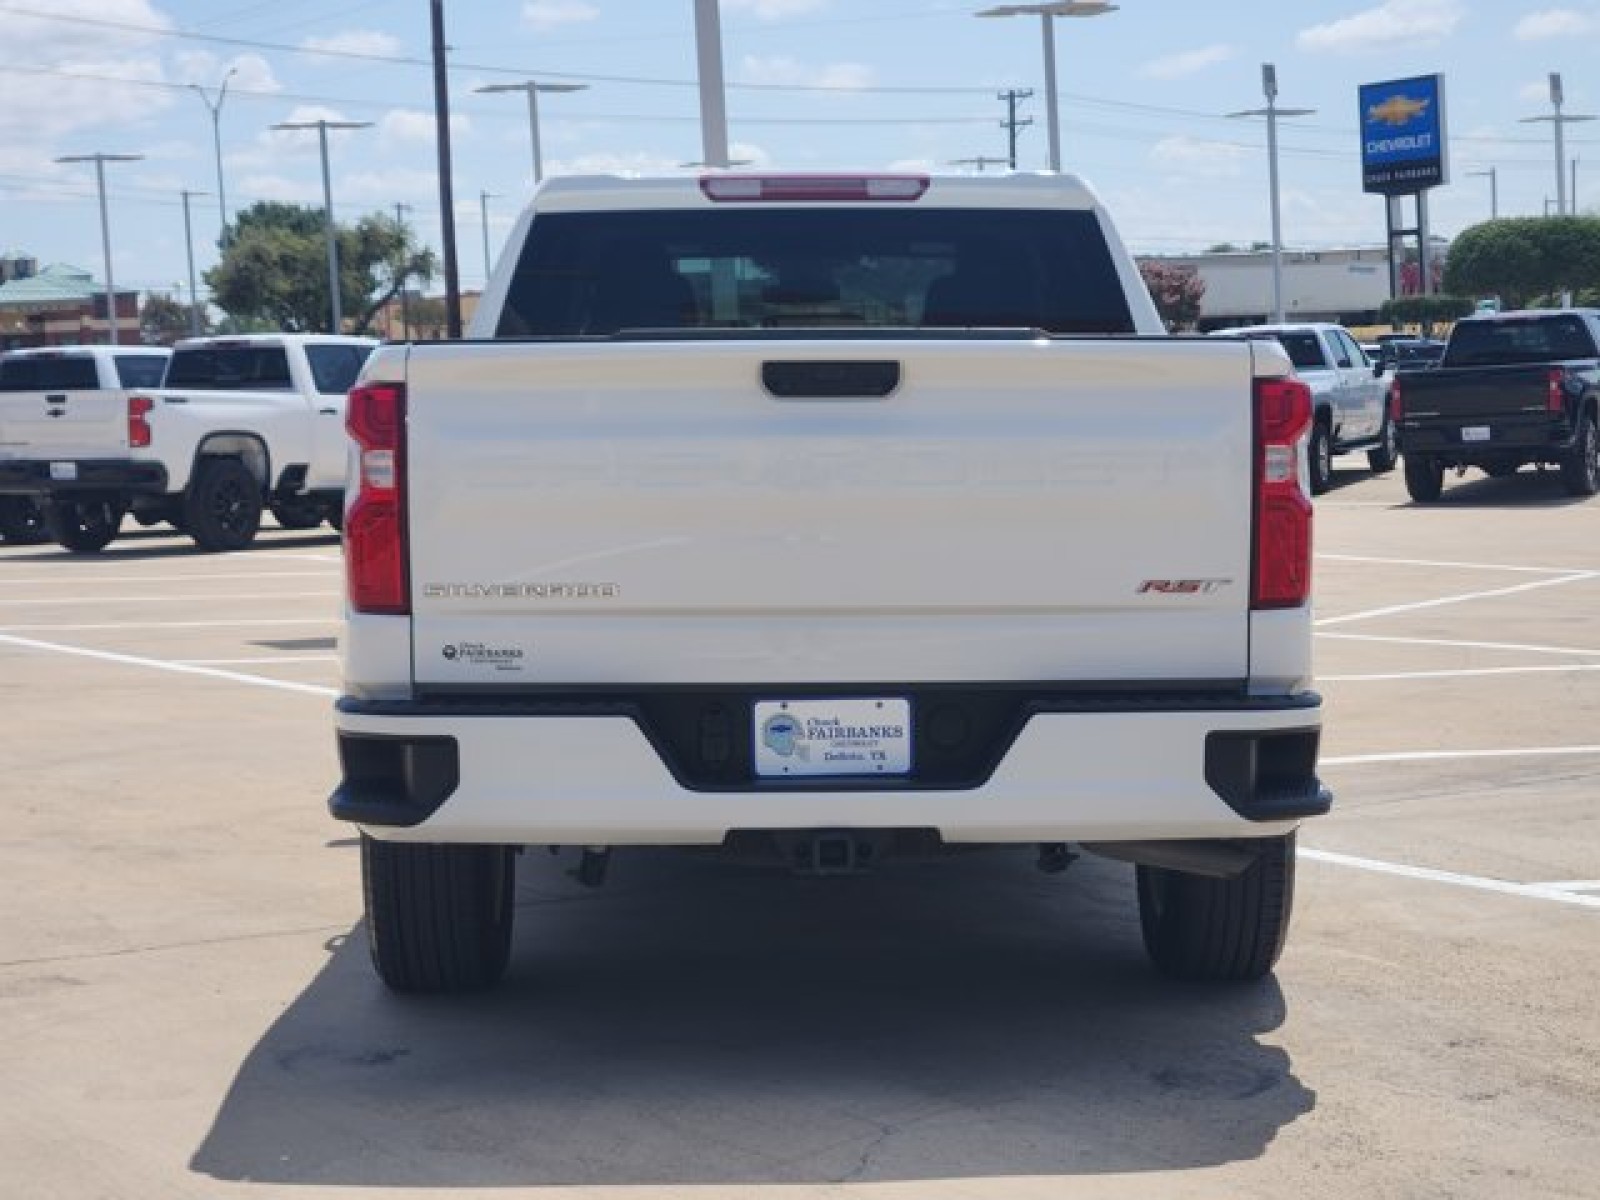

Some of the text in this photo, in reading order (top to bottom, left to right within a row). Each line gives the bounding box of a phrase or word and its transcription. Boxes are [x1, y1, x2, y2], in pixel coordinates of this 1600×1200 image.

[1367, 133, 1431, 153] CHEVROLET
[424, 583, 620, 598] SILVERADO
[1136, 578, 1234, 595] RST
[807, 726, 904, 740] FAIRBANKS
